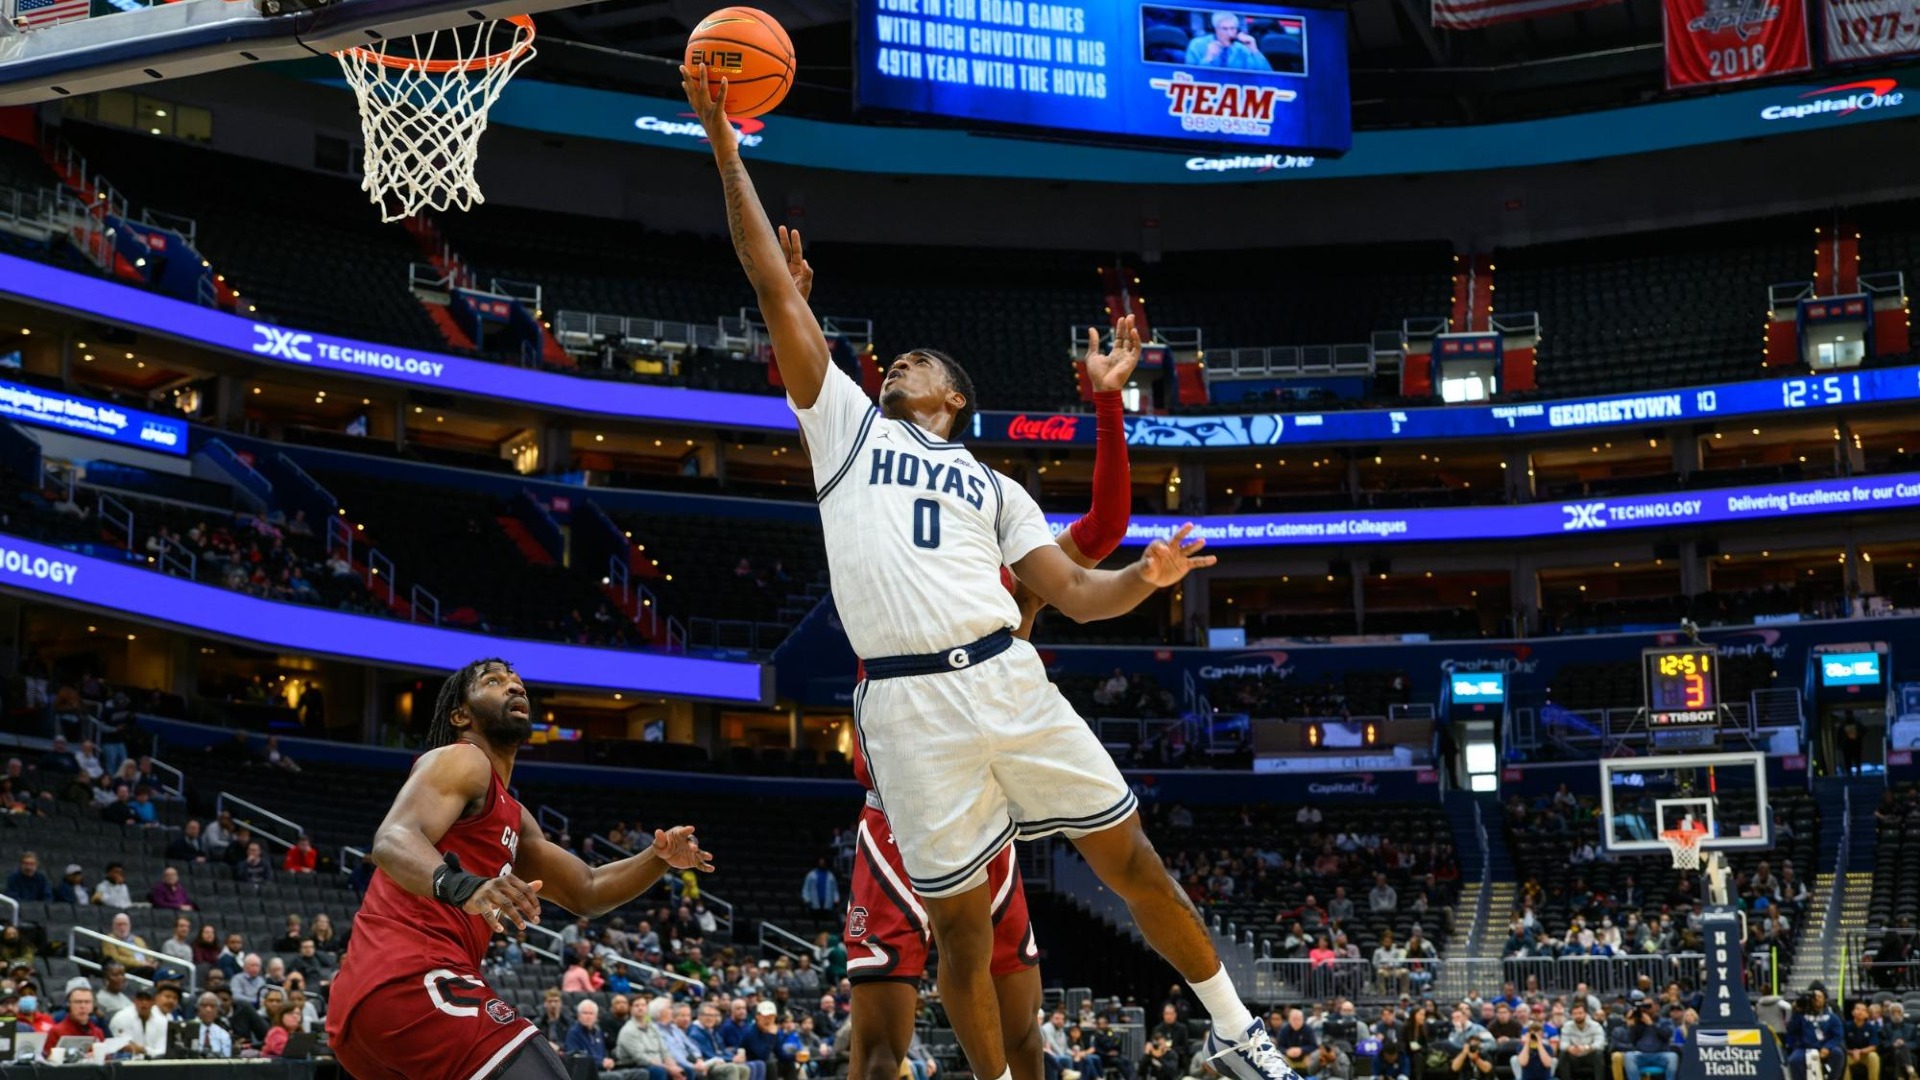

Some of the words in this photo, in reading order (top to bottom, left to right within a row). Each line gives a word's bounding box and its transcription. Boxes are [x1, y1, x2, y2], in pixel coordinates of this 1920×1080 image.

[980, 0, 1024, 27] ROAD
[1028, 2, 1085, 33] GAMES
[877, 14, 922, 46] WITH
[925, 21, 966, 52] RICH
[969, 27, 1051, 62] CHVOTKIN
[1056, 37, 1073, 64] IN
[1077, 39, 1107, 67] HIS
[877, 48, 922, 79] 49TH
[925, 53, 968, 84] YEAR
[972, 59, 1015, 90] WITH
[1018, 64, 1049, 93] THE
[1053, 68, 1107, 99] HOYAS
[1709, 44, 1766, 77] 2018
[1169, 83, 1275, 120] TEAM
[252, 323, 313, 362] DXC
[317, 342, 444, 377] TECHNOLOGY
[1783, 375, 1861, 407] 12:51
[1549, 394, 1682, 427] GEORGETOWN
[1697, 390, 1717, 412] 10
[869, 448, 986, 511] HOYAS
[913, 498, 940, 549] 0
[1562, 502, 1607, 530] DXC
[1608, 500, 1702, 522] TECHNOLOGY
[1728, 493, 1788, 512] Delivering
[1789, 489, 1851, 507] Excellence
[1852, 486, 1871, 501] for
[1872, 486, 1894, 499] our
[1126, 522, 1171, 541] elivering
[1227, 523, 1244, 538] for
[1246, 525, 1265, 537] our
[1267, 522, 1324, 537] Customers
[1326, 520, 1347, 534] and
[1349, 519, 1407, 537] Colleagues
[948, 648, 970, 668] G
[1660, 654, 1709, 676] 12:51
[1685, 674, 1705, 707] 3
[1671, 711, 1716, 723] TISSOT
[1713, 931, 1731, 1017] HOYAS
[1698, 1046, 1762, 1061] MedStar
[1705, 1061, 1757, 1076] Health
